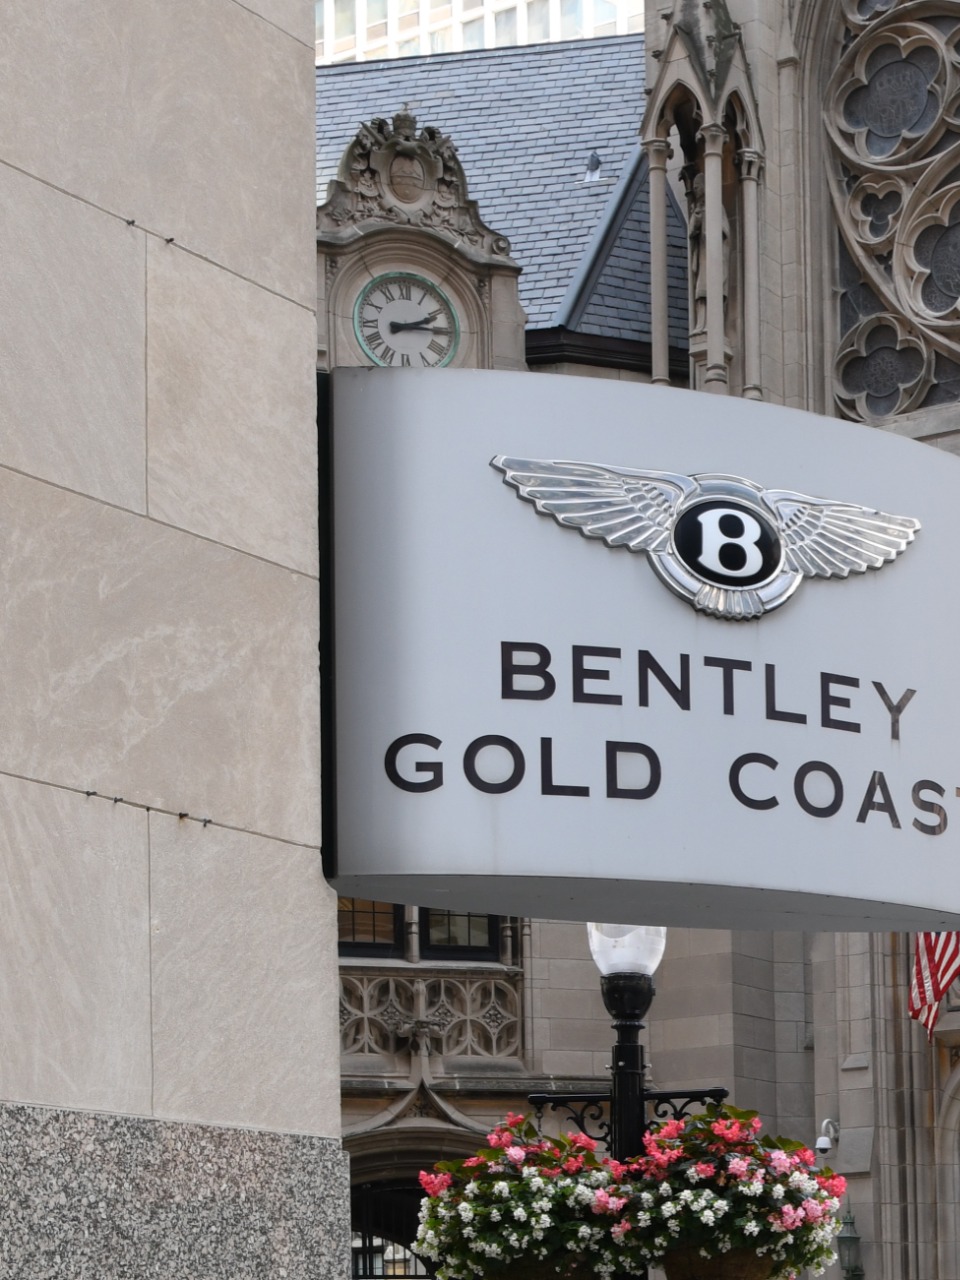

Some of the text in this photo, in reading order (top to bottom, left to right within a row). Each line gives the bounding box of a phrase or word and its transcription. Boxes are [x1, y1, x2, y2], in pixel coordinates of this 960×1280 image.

[696, 507, 763, 579] B
[500, 641, 917, 741] BENTLEY
[384, 733, 662, 800] GOLD
